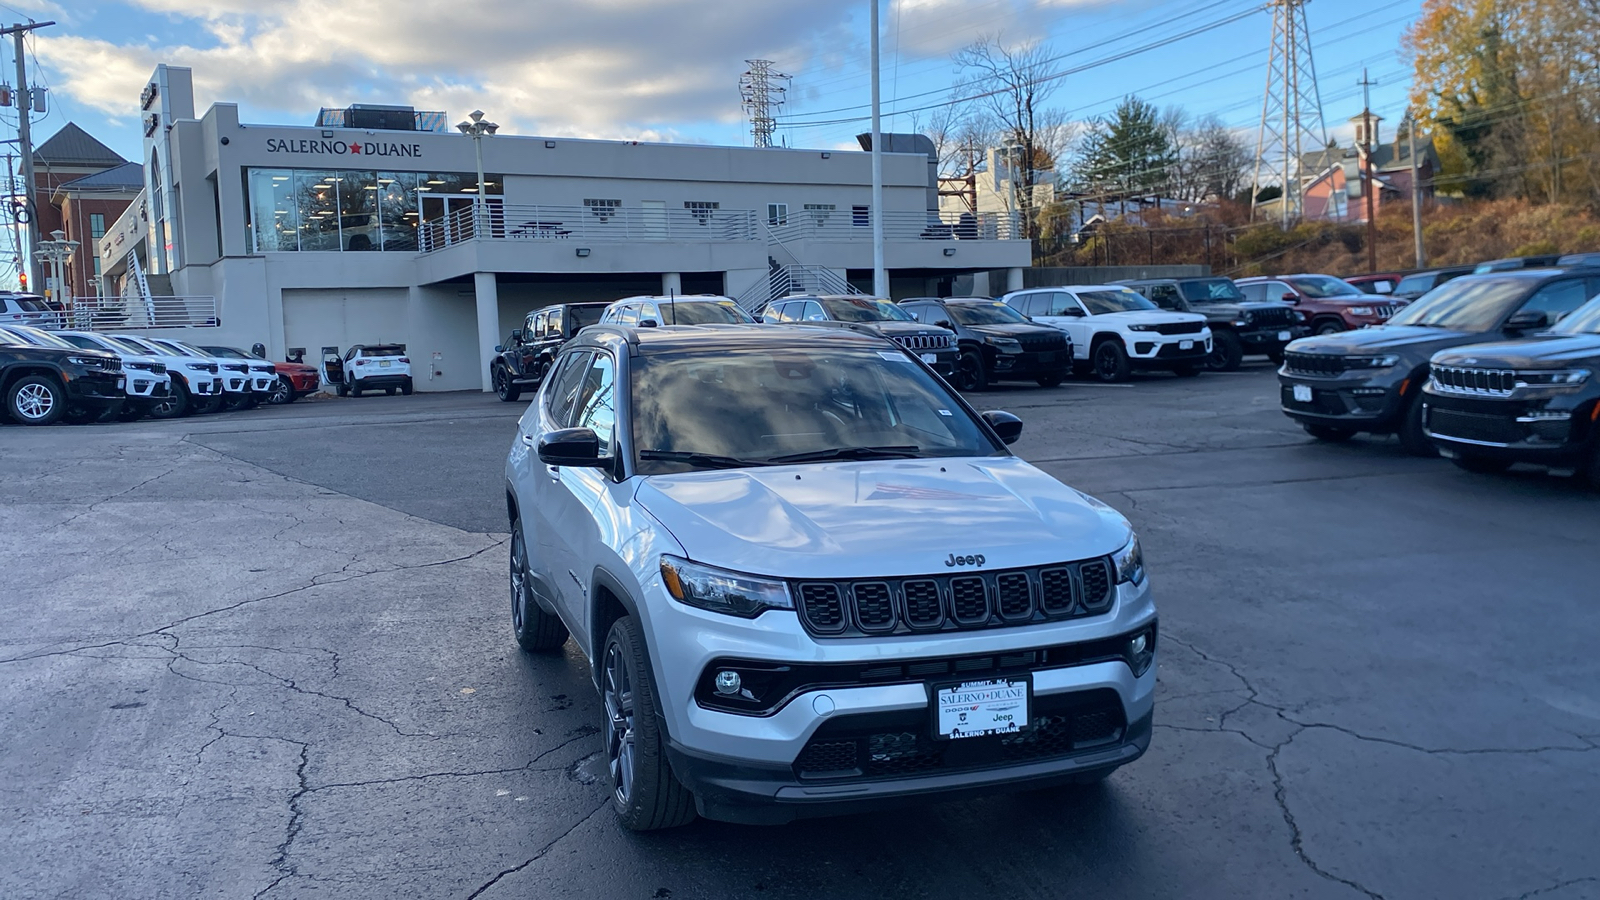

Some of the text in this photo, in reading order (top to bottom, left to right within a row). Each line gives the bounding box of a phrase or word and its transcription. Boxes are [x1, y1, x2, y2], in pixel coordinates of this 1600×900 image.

[266, 138, 422, 157] SALERNO DUANE
[944, 553, 986, 567] Jeep
[941, 692, 985, 705] SALERNO
[990, 688, 1024, 700] DUANE
[992, 713, 1013, 722] Jeep
[949, 726, 1021, 739] SALERNO DUANE
